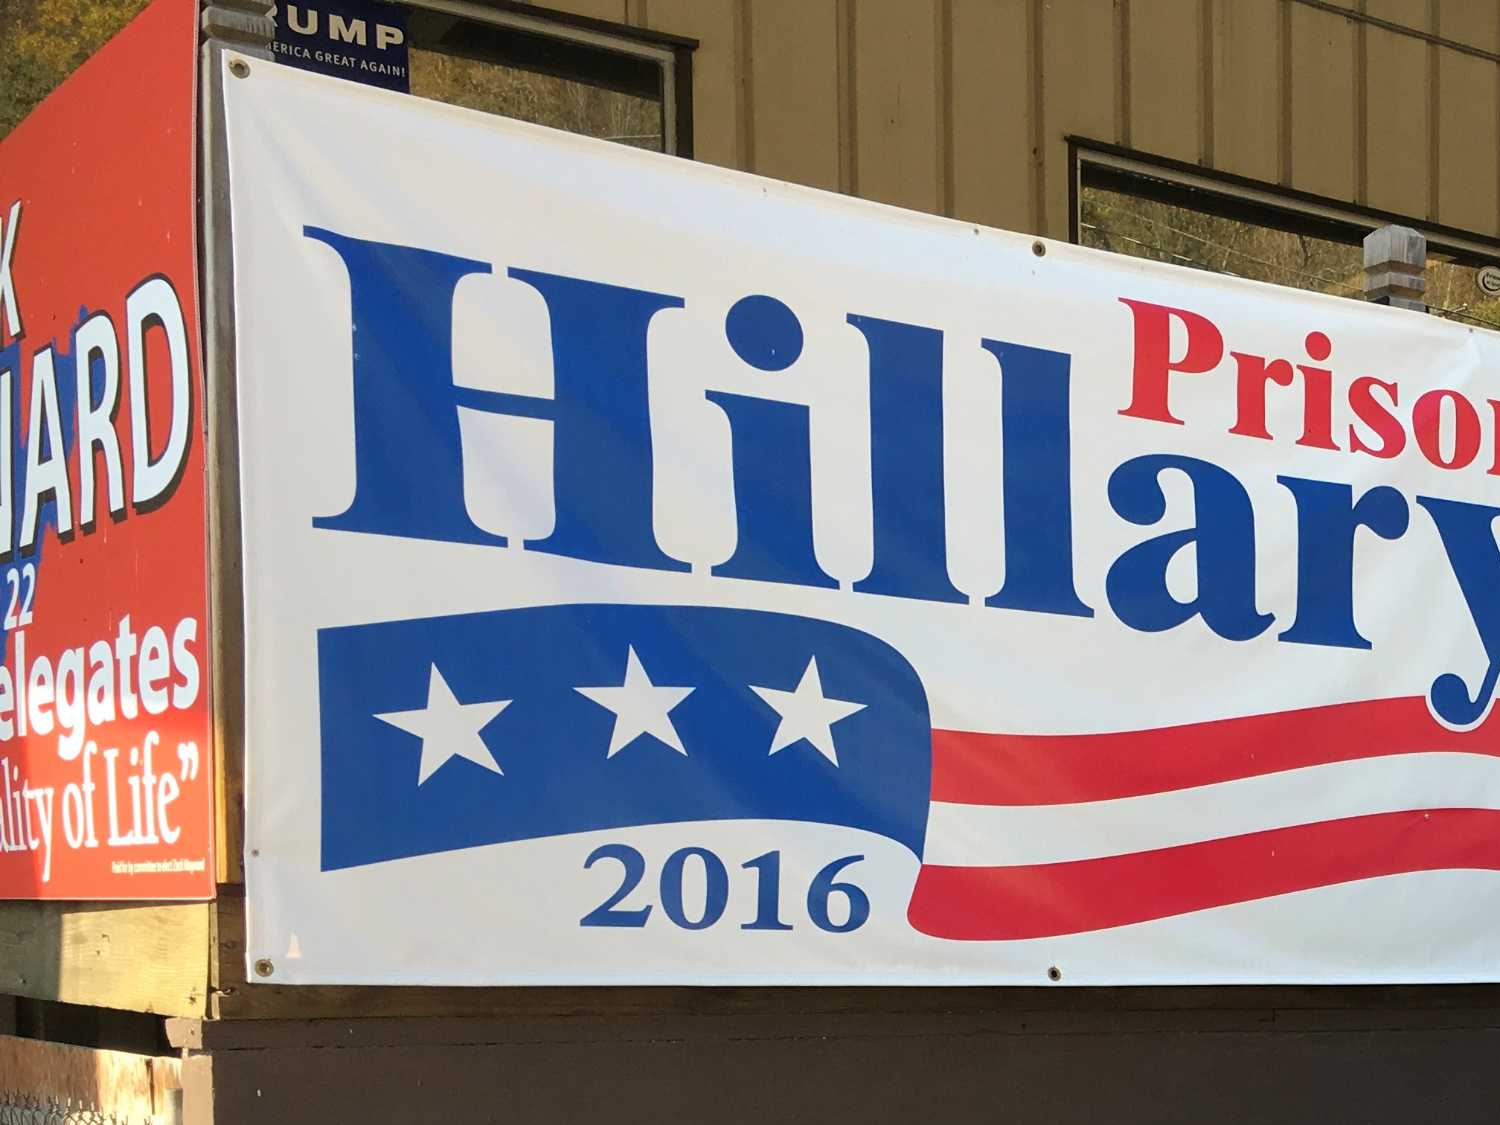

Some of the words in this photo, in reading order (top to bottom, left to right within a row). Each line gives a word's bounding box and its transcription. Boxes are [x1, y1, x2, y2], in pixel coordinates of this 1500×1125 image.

[315, 51, 356, 67] GREAT
[360, 60, 406, 78] AGAIN!
[62, 740, 98, 849] of
[579, 844, 870, 933] 2016
